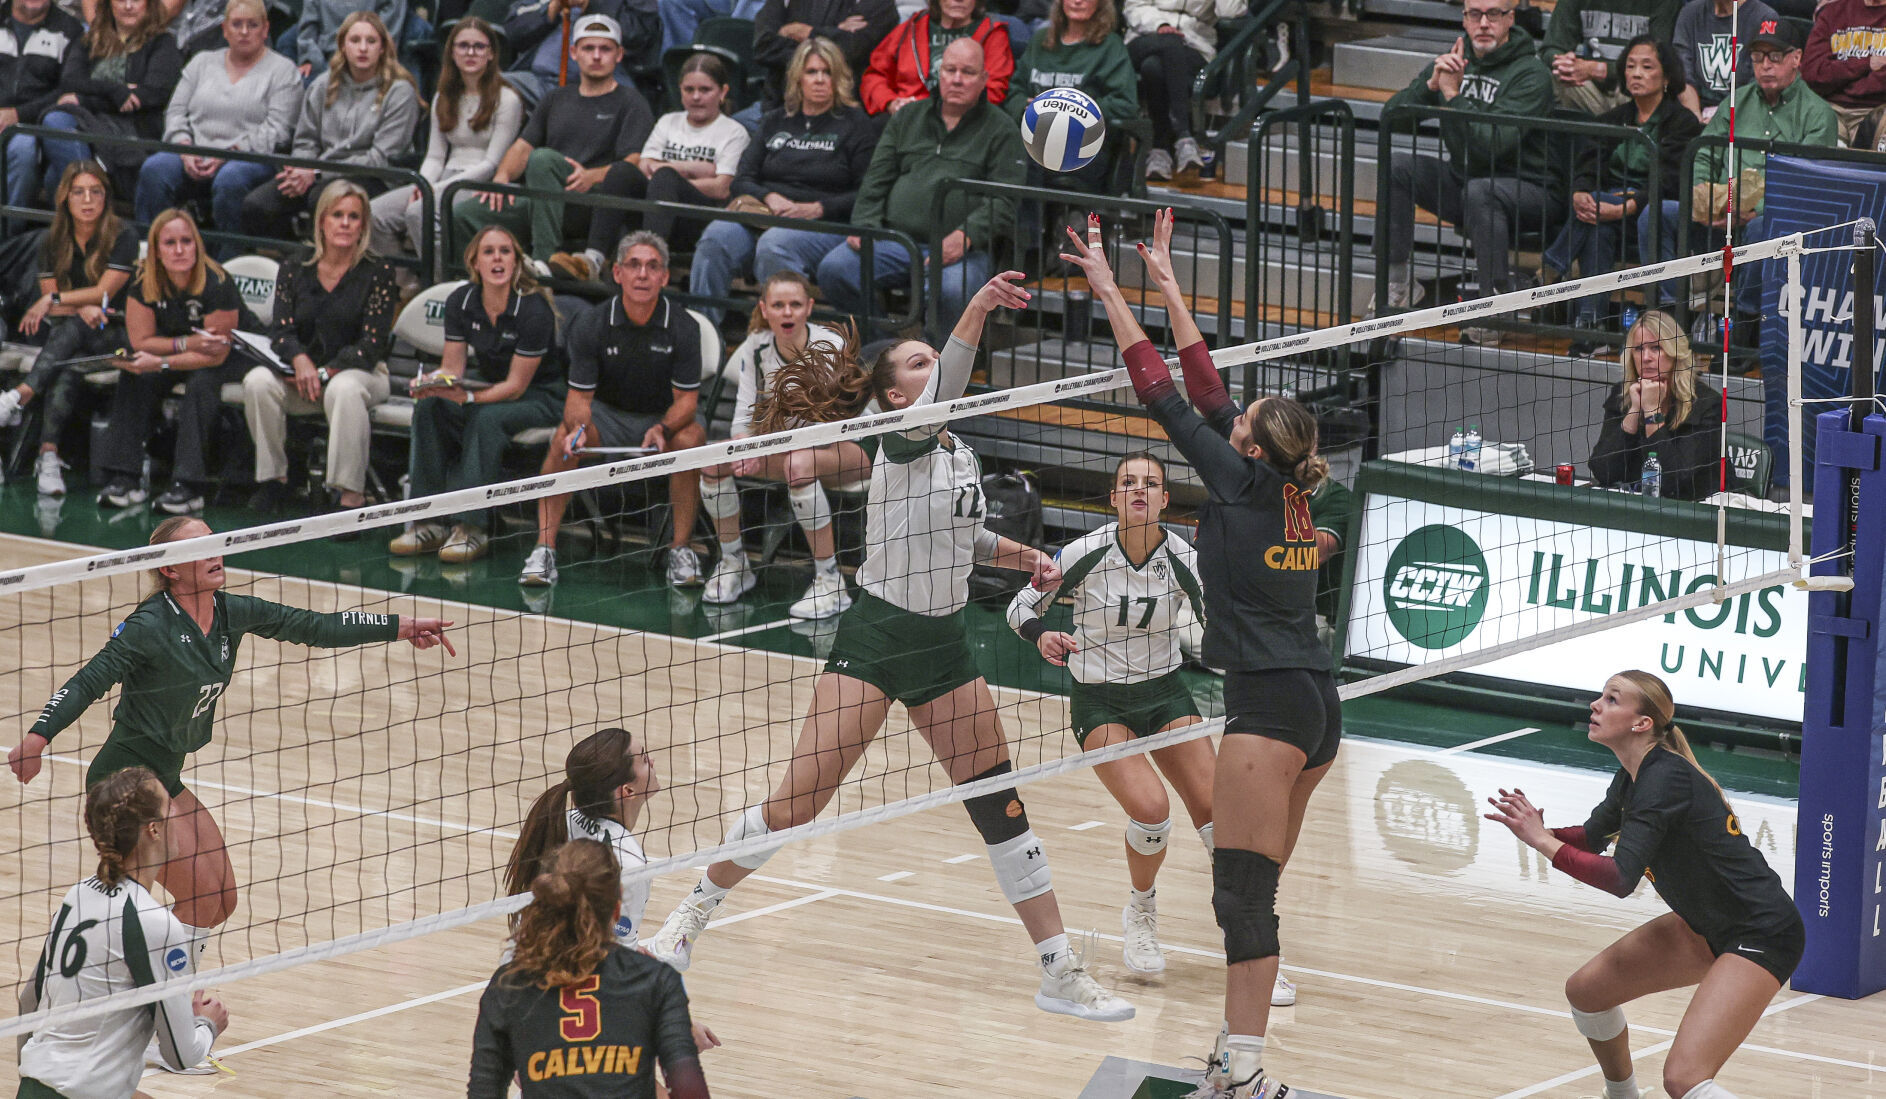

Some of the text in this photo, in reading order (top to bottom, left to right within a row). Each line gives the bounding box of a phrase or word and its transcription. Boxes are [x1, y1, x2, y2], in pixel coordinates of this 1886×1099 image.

[1043, 100, 1088, 119] molten
[953, 483, 982, 518] 12
[1283, 483, 1315, 542] 18
[1264, 545, 1319, 571] CALVI
[1389, 565, 1484, 608] CCIW
[1527, 551, 1785, 637] ILLINOIS
[1116, 595, 1158, 629] 17
[1818, 813, 1834, 918] sports imports
[46, 903, 99, 978] 16
[559, 974, 602, 1042] 5
[527, 1045, 643, 1082] CALVIN
